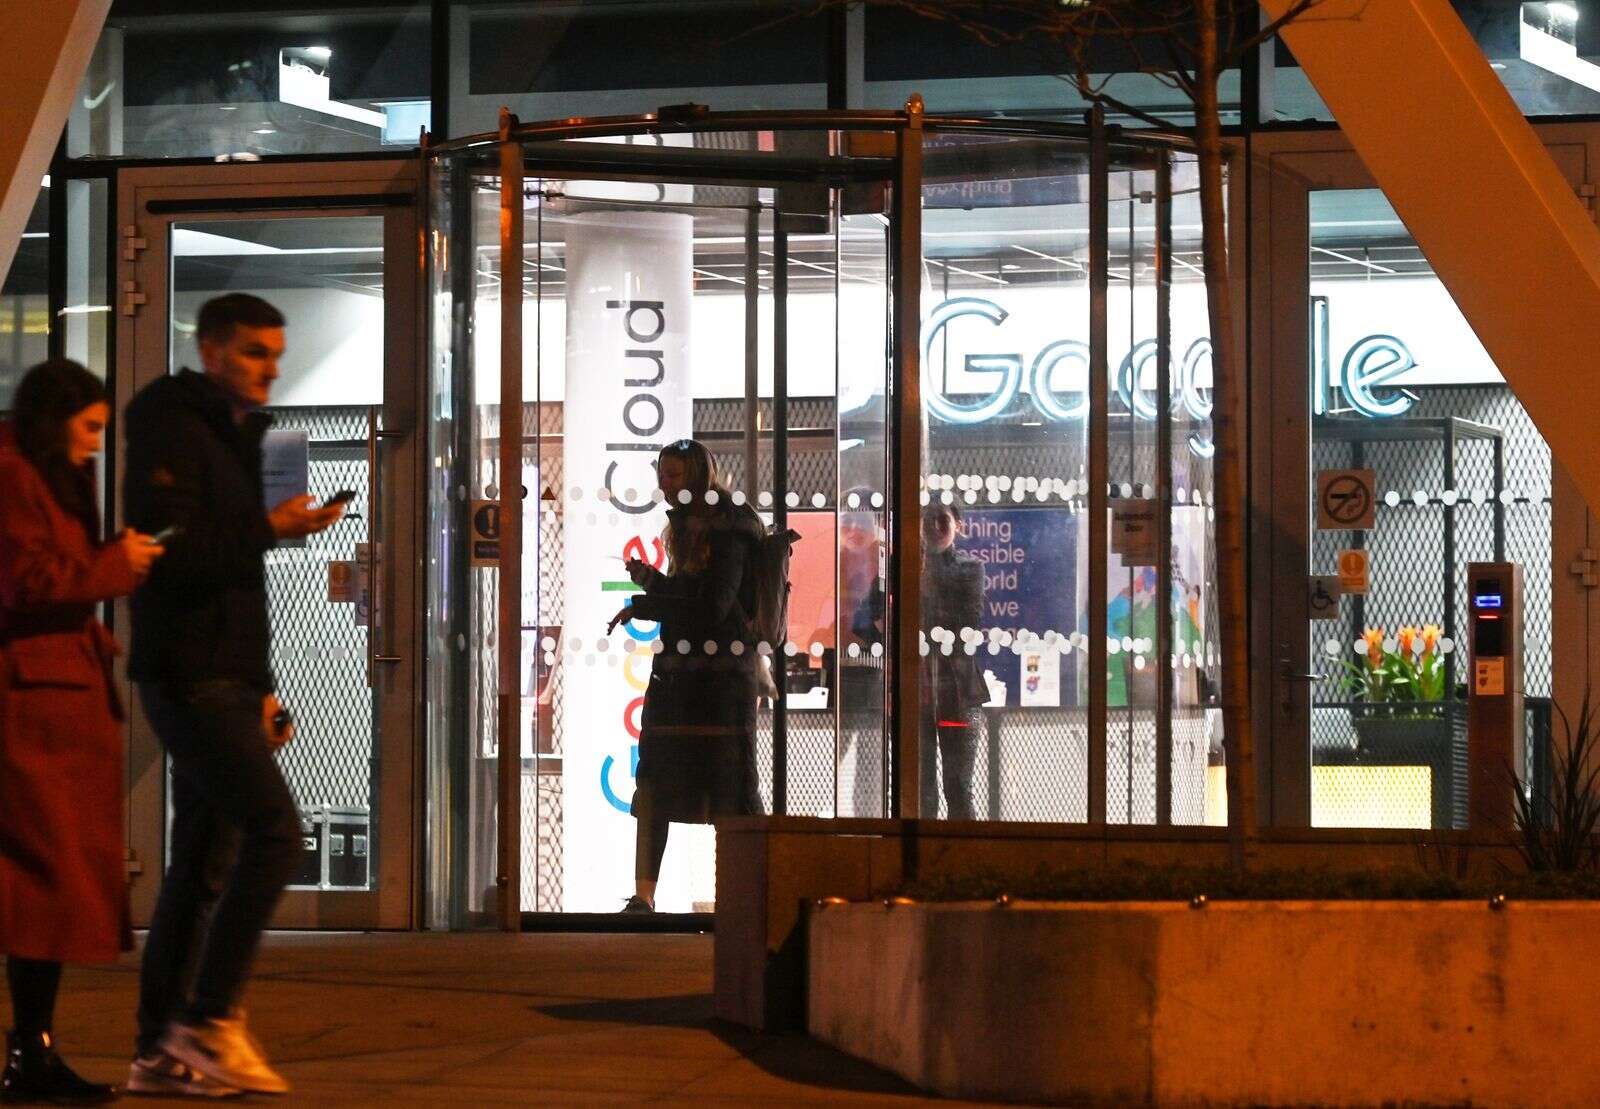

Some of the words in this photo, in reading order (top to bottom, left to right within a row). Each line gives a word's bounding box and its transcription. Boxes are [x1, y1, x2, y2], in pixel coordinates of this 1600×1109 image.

[605, 300, 665, 515] Cloud
[961, 517, 1012, 543] thing
[957, 543, 1025, 564] ossible
[983, 569, 1018, 591] orld
[988, 600, 1020, 617] we
